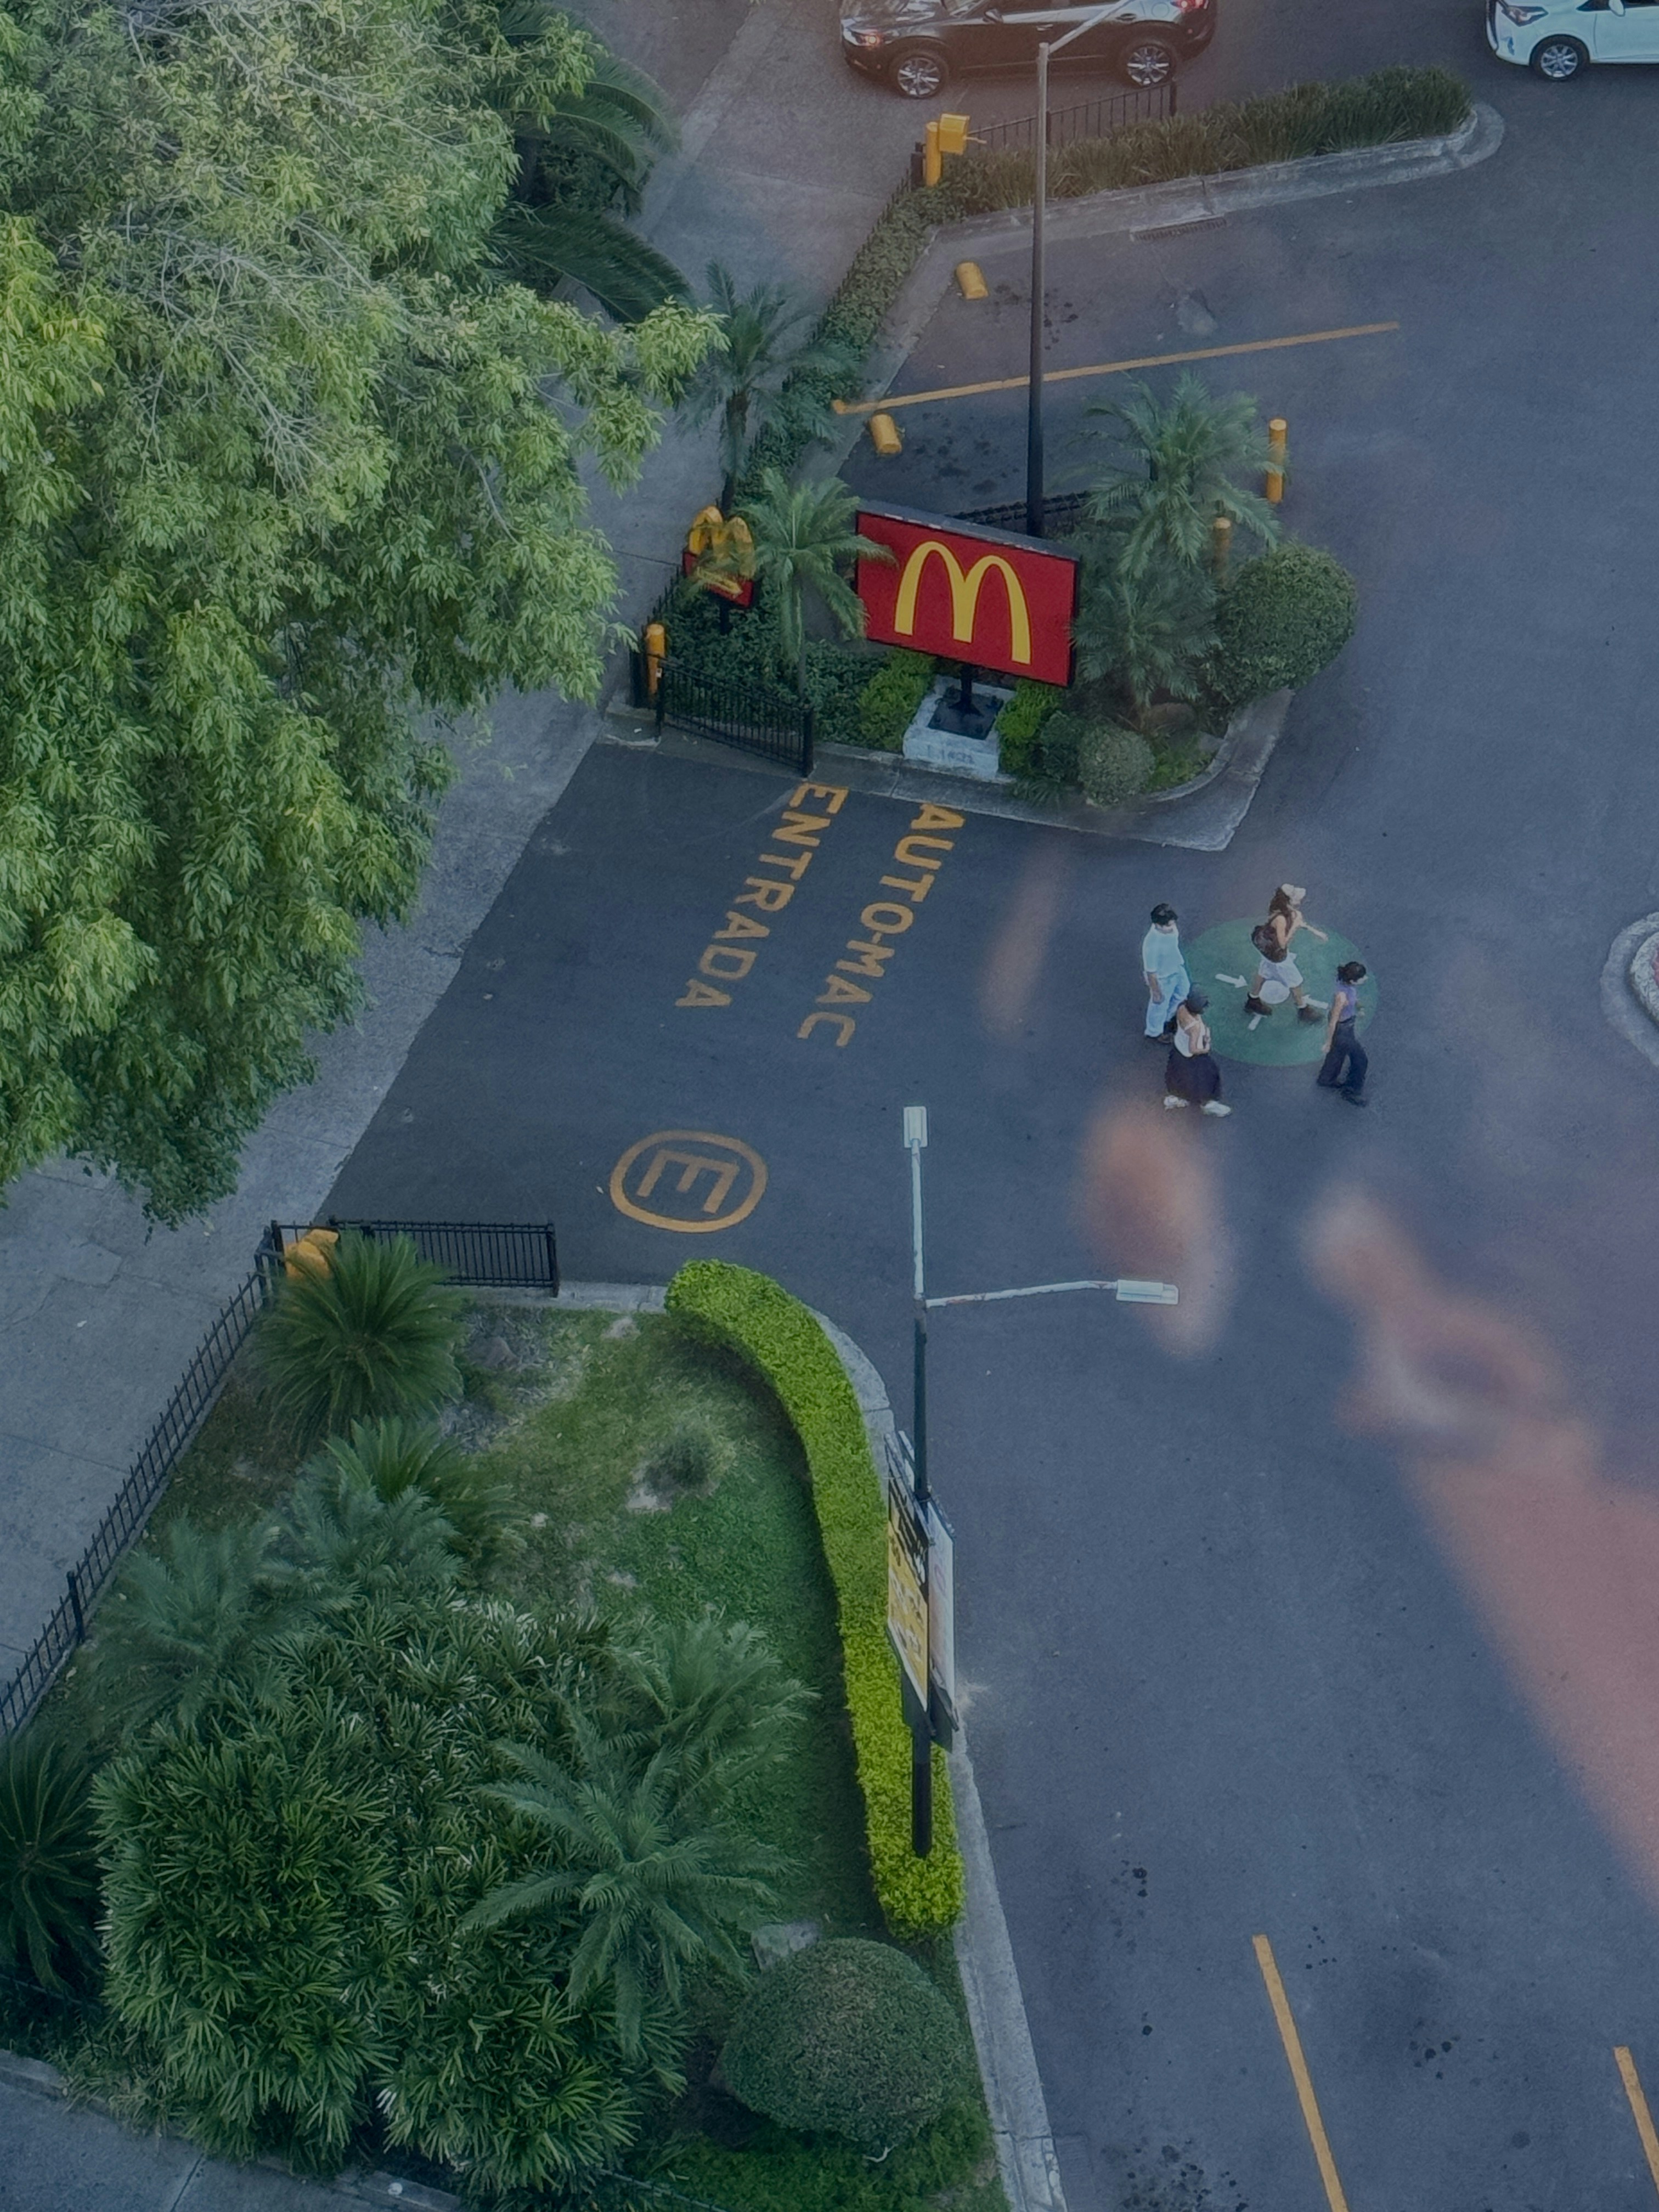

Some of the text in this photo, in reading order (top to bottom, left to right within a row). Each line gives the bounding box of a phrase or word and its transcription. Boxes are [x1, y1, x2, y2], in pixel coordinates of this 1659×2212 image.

[674, 782, 849, 1007] ENTRADA
[797, 803, 966, 1047] AUTO-MAC
[637, 1149, 739, 1215] E
